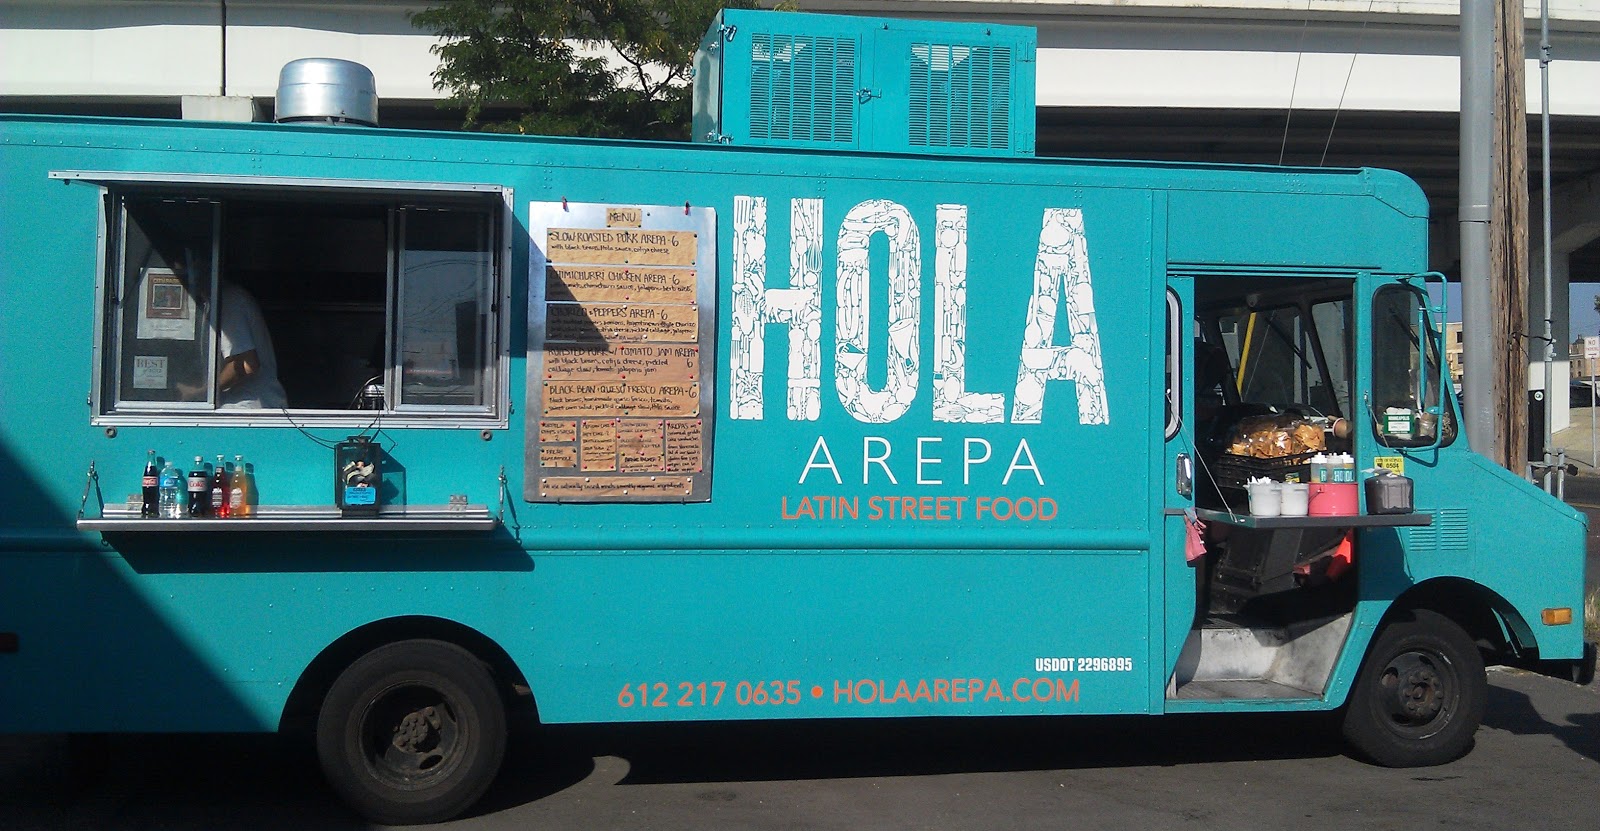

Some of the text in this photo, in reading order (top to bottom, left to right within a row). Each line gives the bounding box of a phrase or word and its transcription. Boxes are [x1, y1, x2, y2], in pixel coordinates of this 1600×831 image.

[609, 213, 636, 222] MENU
[617, 232, 638, 244] PORK
[641, 234, 666, 245] AREPA
[608, 271, 641, 283] CHICKEN
[644, 273, 666, 284] AREPA
[593, 307, 628, 318] PEPPERS
[629, 308, 655, 319] AREPA
[729, 195, 1110, 425] HOLA
[620, 347, 653, 357] TOMATO
[656, 348, 672, 358] JAM
[136, 358, 166, 368] BEST
[687, 358, 693, 368] 6
[549, 385, 574, 395] BLACK
[576, 385, 596, 395] BEAN
[628, 386, 656, 396] FRESCO
[798, 436, 1044, 485] AREPA
[781, 496, 1058, 520] LATIN STREET FOOD
[1035, 657, 1133, 672] USDOT 2296895
[618, 678, 1080, 707] 612 217 0635 HOLAAREPA.COM
